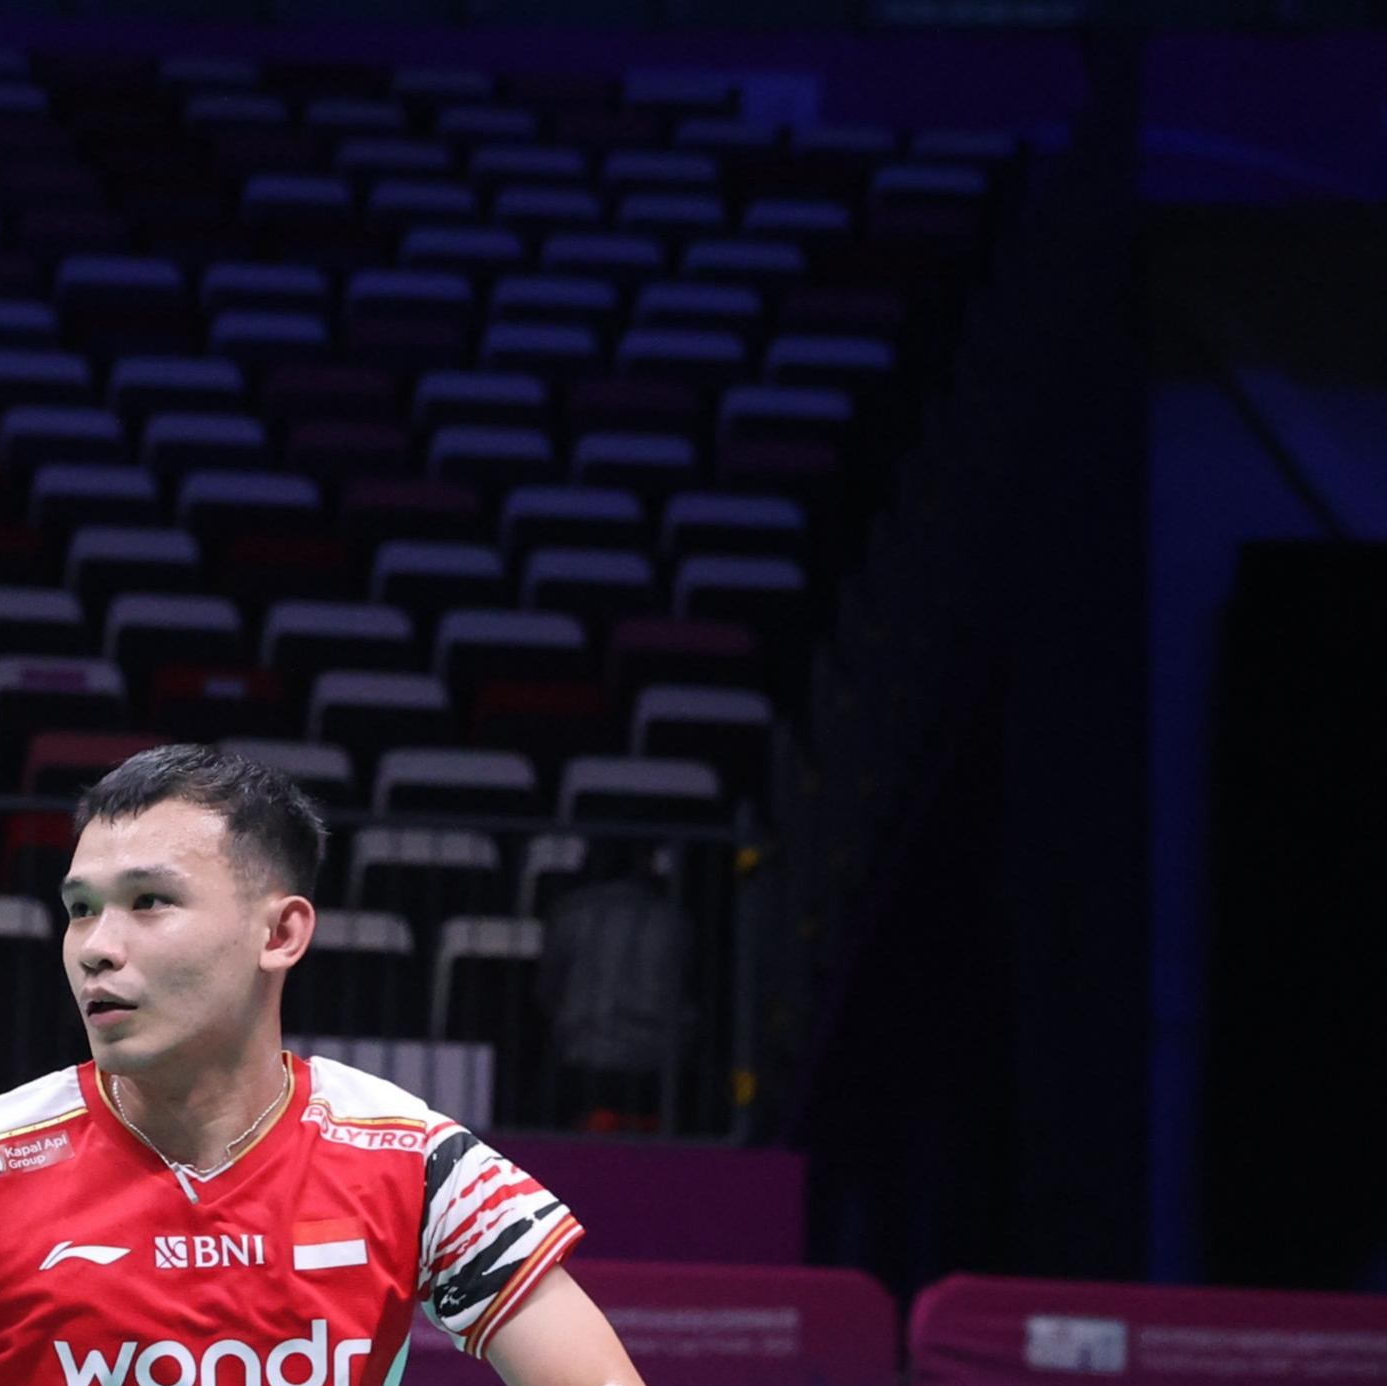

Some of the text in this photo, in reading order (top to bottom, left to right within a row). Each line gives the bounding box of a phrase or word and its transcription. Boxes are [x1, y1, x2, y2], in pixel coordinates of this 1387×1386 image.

[5, 1134, 68, 1158] Kapal Api
[8, 1154, 46, 1169] Group
[192, 1234, 265, 1268] BNI
